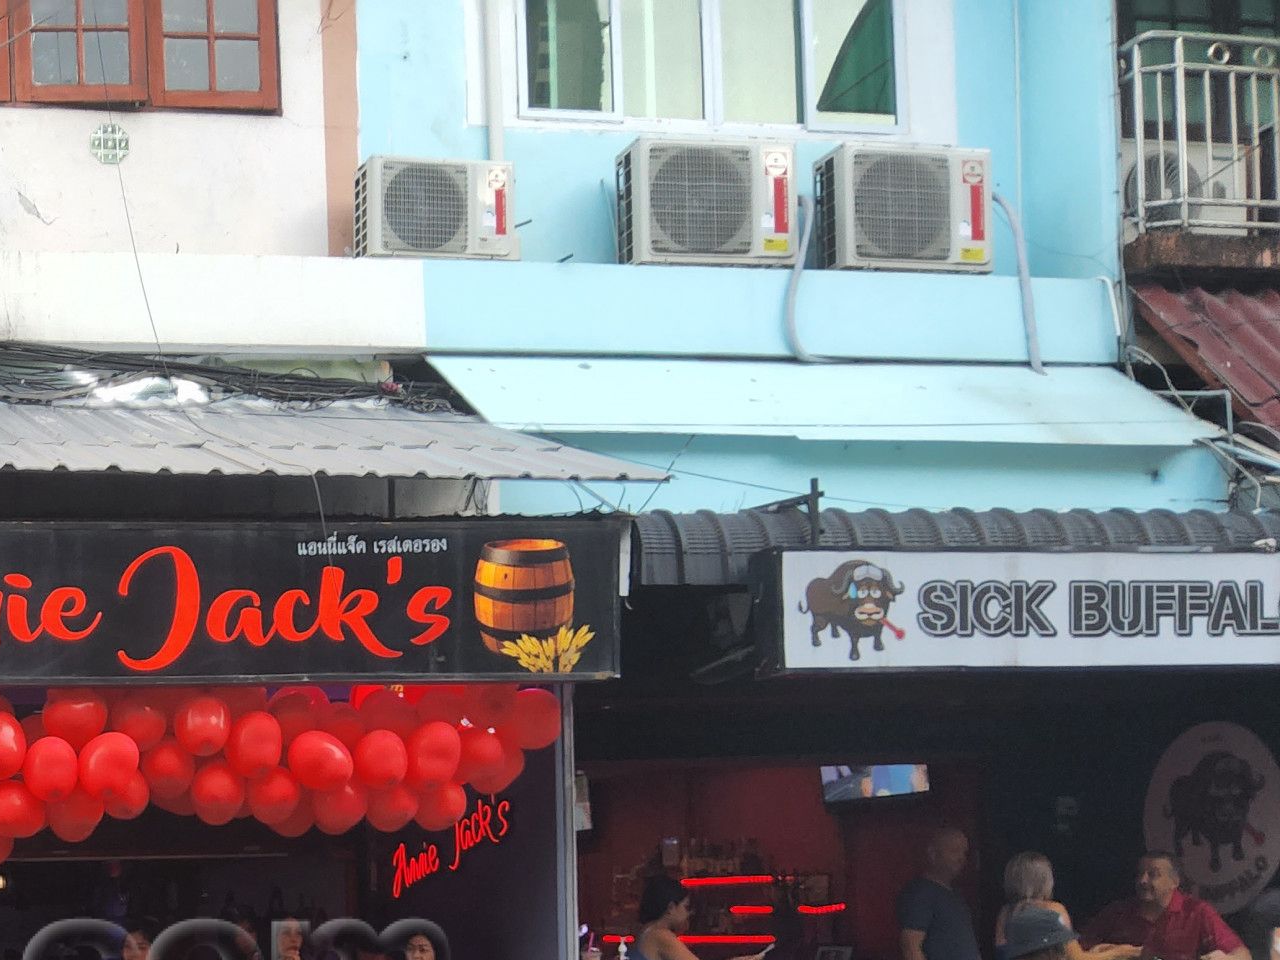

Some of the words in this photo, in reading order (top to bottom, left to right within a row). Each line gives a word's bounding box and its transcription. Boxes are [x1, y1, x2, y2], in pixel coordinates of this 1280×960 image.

[117, 545, 453, 672] Jack's
[917, 580, 1057, 637] SICK
[1068, 580, 1280, 637] BUFFAL
[448, 793, 510, 871] Jack's
